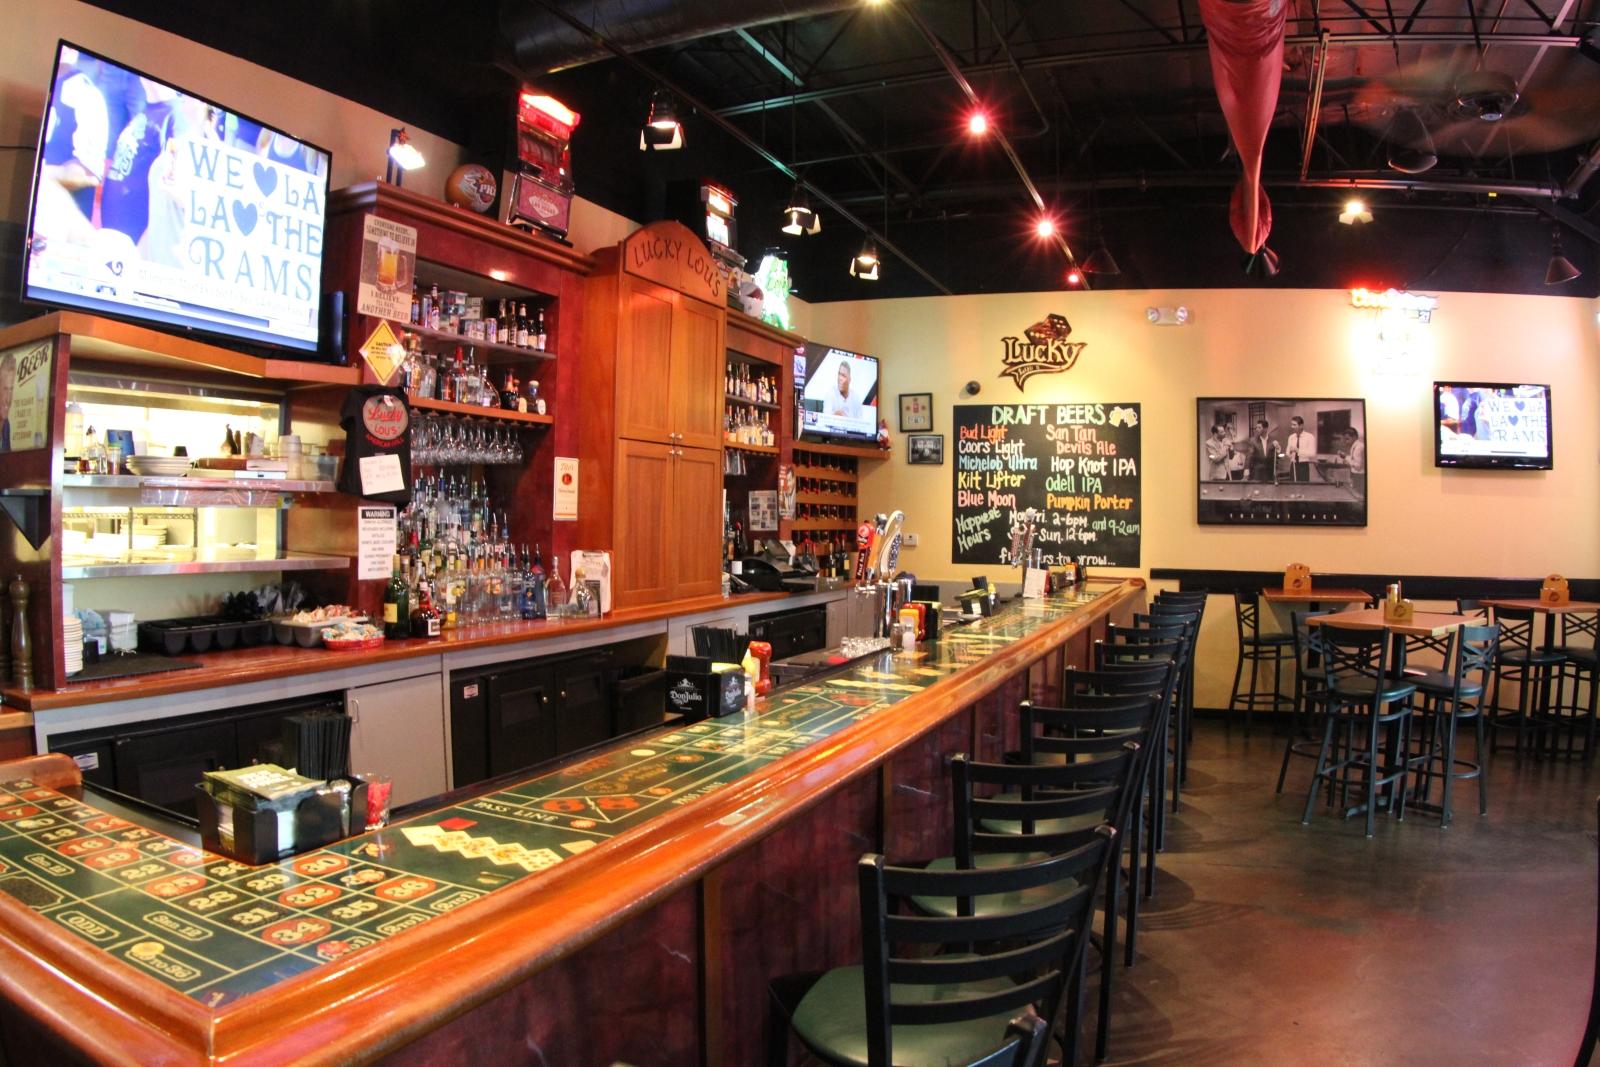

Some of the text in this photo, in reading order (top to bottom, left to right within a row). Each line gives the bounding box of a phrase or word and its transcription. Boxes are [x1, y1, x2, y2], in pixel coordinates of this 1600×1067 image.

[189, 141, 320, 215] WE LA
[190, 190, 322, 258] LA THE
[189, 235, 312, 302] RAMS
[634, 238, 720, 297] LUCKY LOU'S
[361, 303, 392, 315] ANOTHER
[17, 345, 49, 382] BEER
[1002, 338, 1086, 372] Lucky
[367, 405, 403, 422] Lucky
[991, 404, 1106, 425] DRAFT BEERS
[1488, 401, 1509, 412] WE
[1491, 415, 1547, 427] LA THE
[960, 423, 1008, 444] Bud Light
[1046, 424, 1097, 443] San Tan
[1492, 430, 1546, 442] RAMS
[958, 439, 1025, 460] Coors Light
[1056, 441, 1117, 455] Devils Ale
[959, 455, 1037, 472] Michelob Ultra
[1051, 456, 1137, 477] Hop Knot IPA
[958, 471, 1026, 490] Kilt Lifter
[1045, 473, 1102, 493] Odell IPA
[958, 490, 1017, 511] Blue Moon
[1046, 493, 1133, 512] Pumpkin Porter
[365, 510, 391, 518] WARNING
[955, 507, 1002, 535] Happiest
[1092, 516, 1140, 536] and 9-2am
[957, 528, 991, 554] Hours
[473, 801, 559, 822] PASS LINE
[68, 840, 104, 853] 16
[95, 852, 132, 865] 19
[299, 857, 342, 873] 30
[120, 864, 166, 880] 22
[247, 873, 290, 890] 29
[286, 887, 334, 904] 32
[384, 880, 430, 898] 36
[188, 891, 238, 910] 28
[332, 899, 379, 919] 35
[68, 916, 106, 936] ODD
[232, 908, 279, 925] 31
[271, 921, 325, 942] 34
[165, 965, 193, 978] 36
